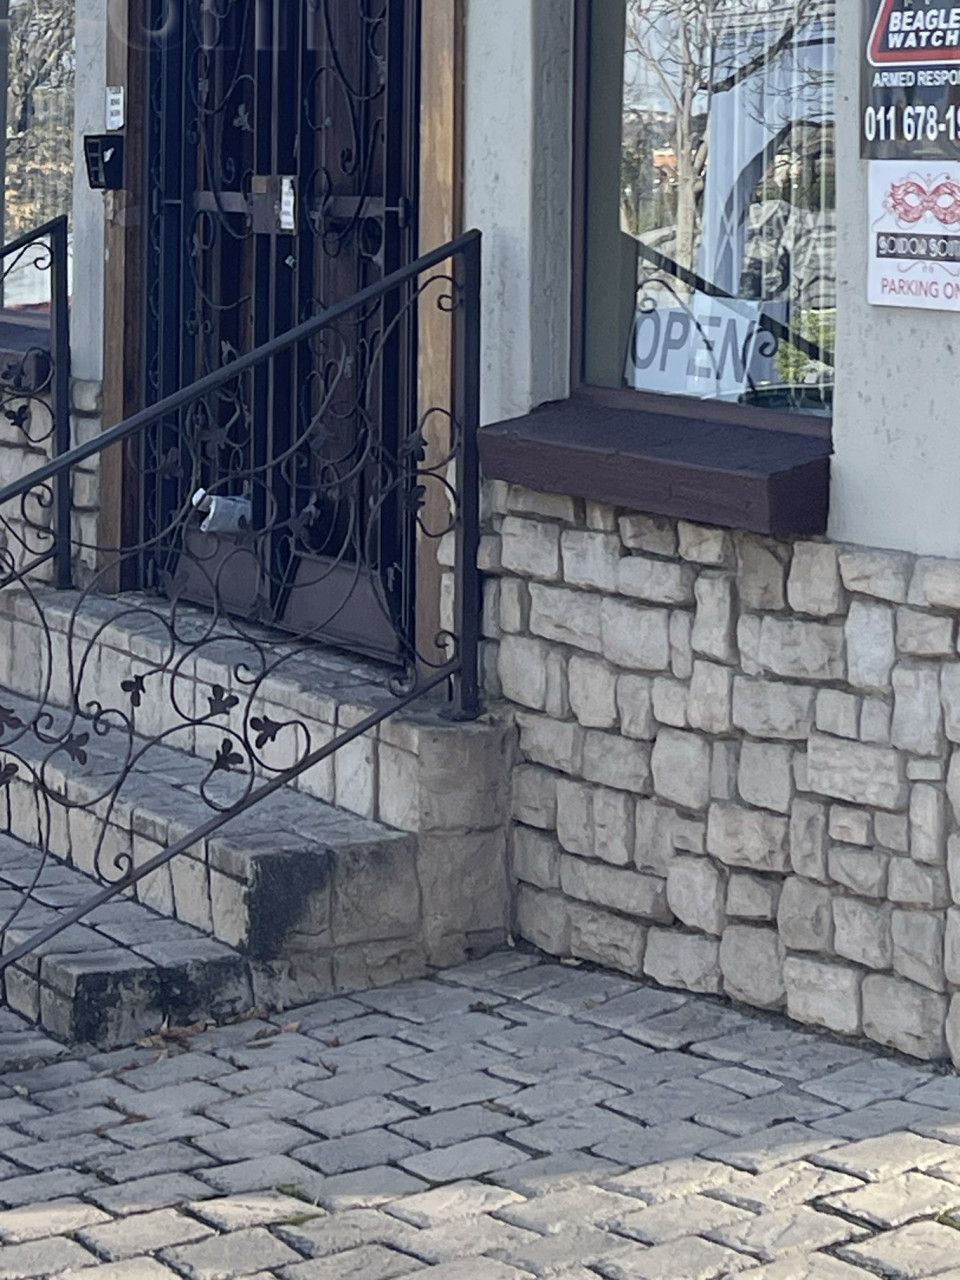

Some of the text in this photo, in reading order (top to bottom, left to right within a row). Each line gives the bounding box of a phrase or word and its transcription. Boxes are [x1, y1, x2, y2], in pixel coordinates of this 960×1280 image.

[888, 8, 960, 32] BEAGLE
[888, 29, 959, 49] WATCH
[872, 69, 960, 87] ARMED RESPO
[864, 106, 896, 141] 011
[881, 277, 939, 298] PARKING
[632, 308, 758, 384] OPEN
